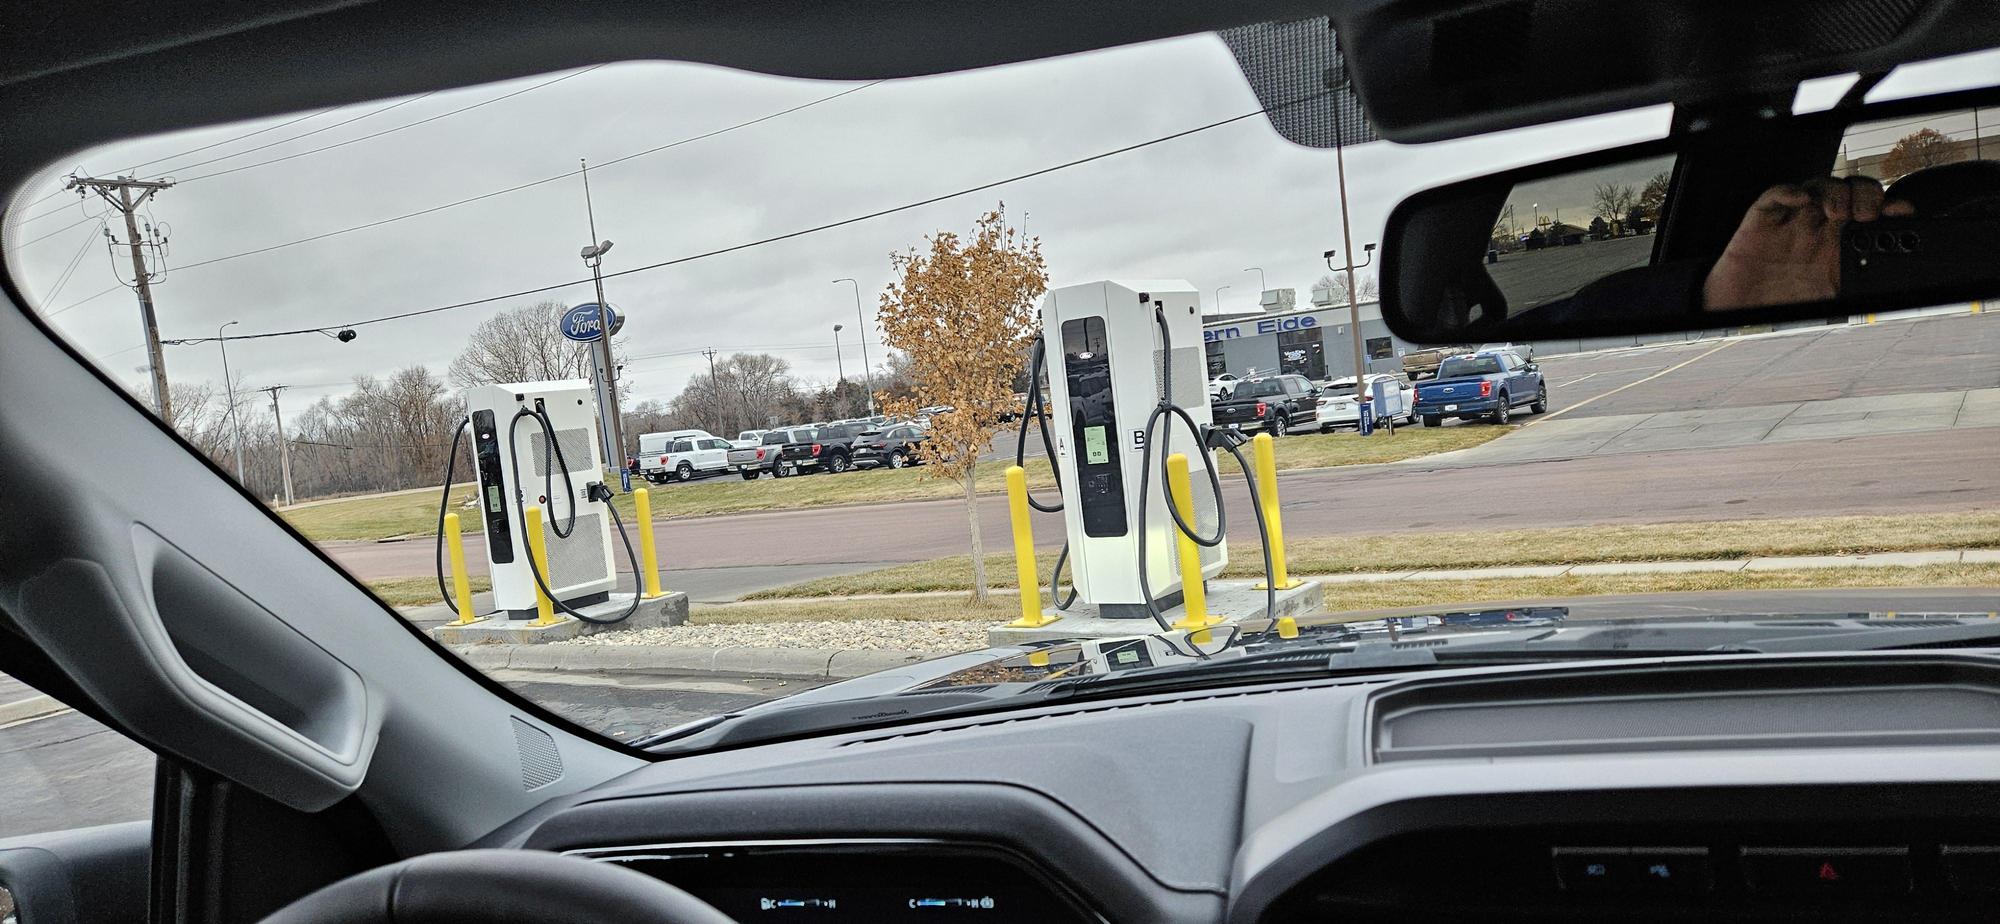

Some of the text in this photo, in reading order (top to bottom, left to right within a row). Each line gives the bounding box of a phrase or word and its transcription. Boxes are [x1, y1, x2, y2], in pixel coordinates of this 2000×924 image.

[1203, 316, 1316, 341] ern Eide
[1133, 430, 1145, 445] B
[908, 898, 916, 909] C
